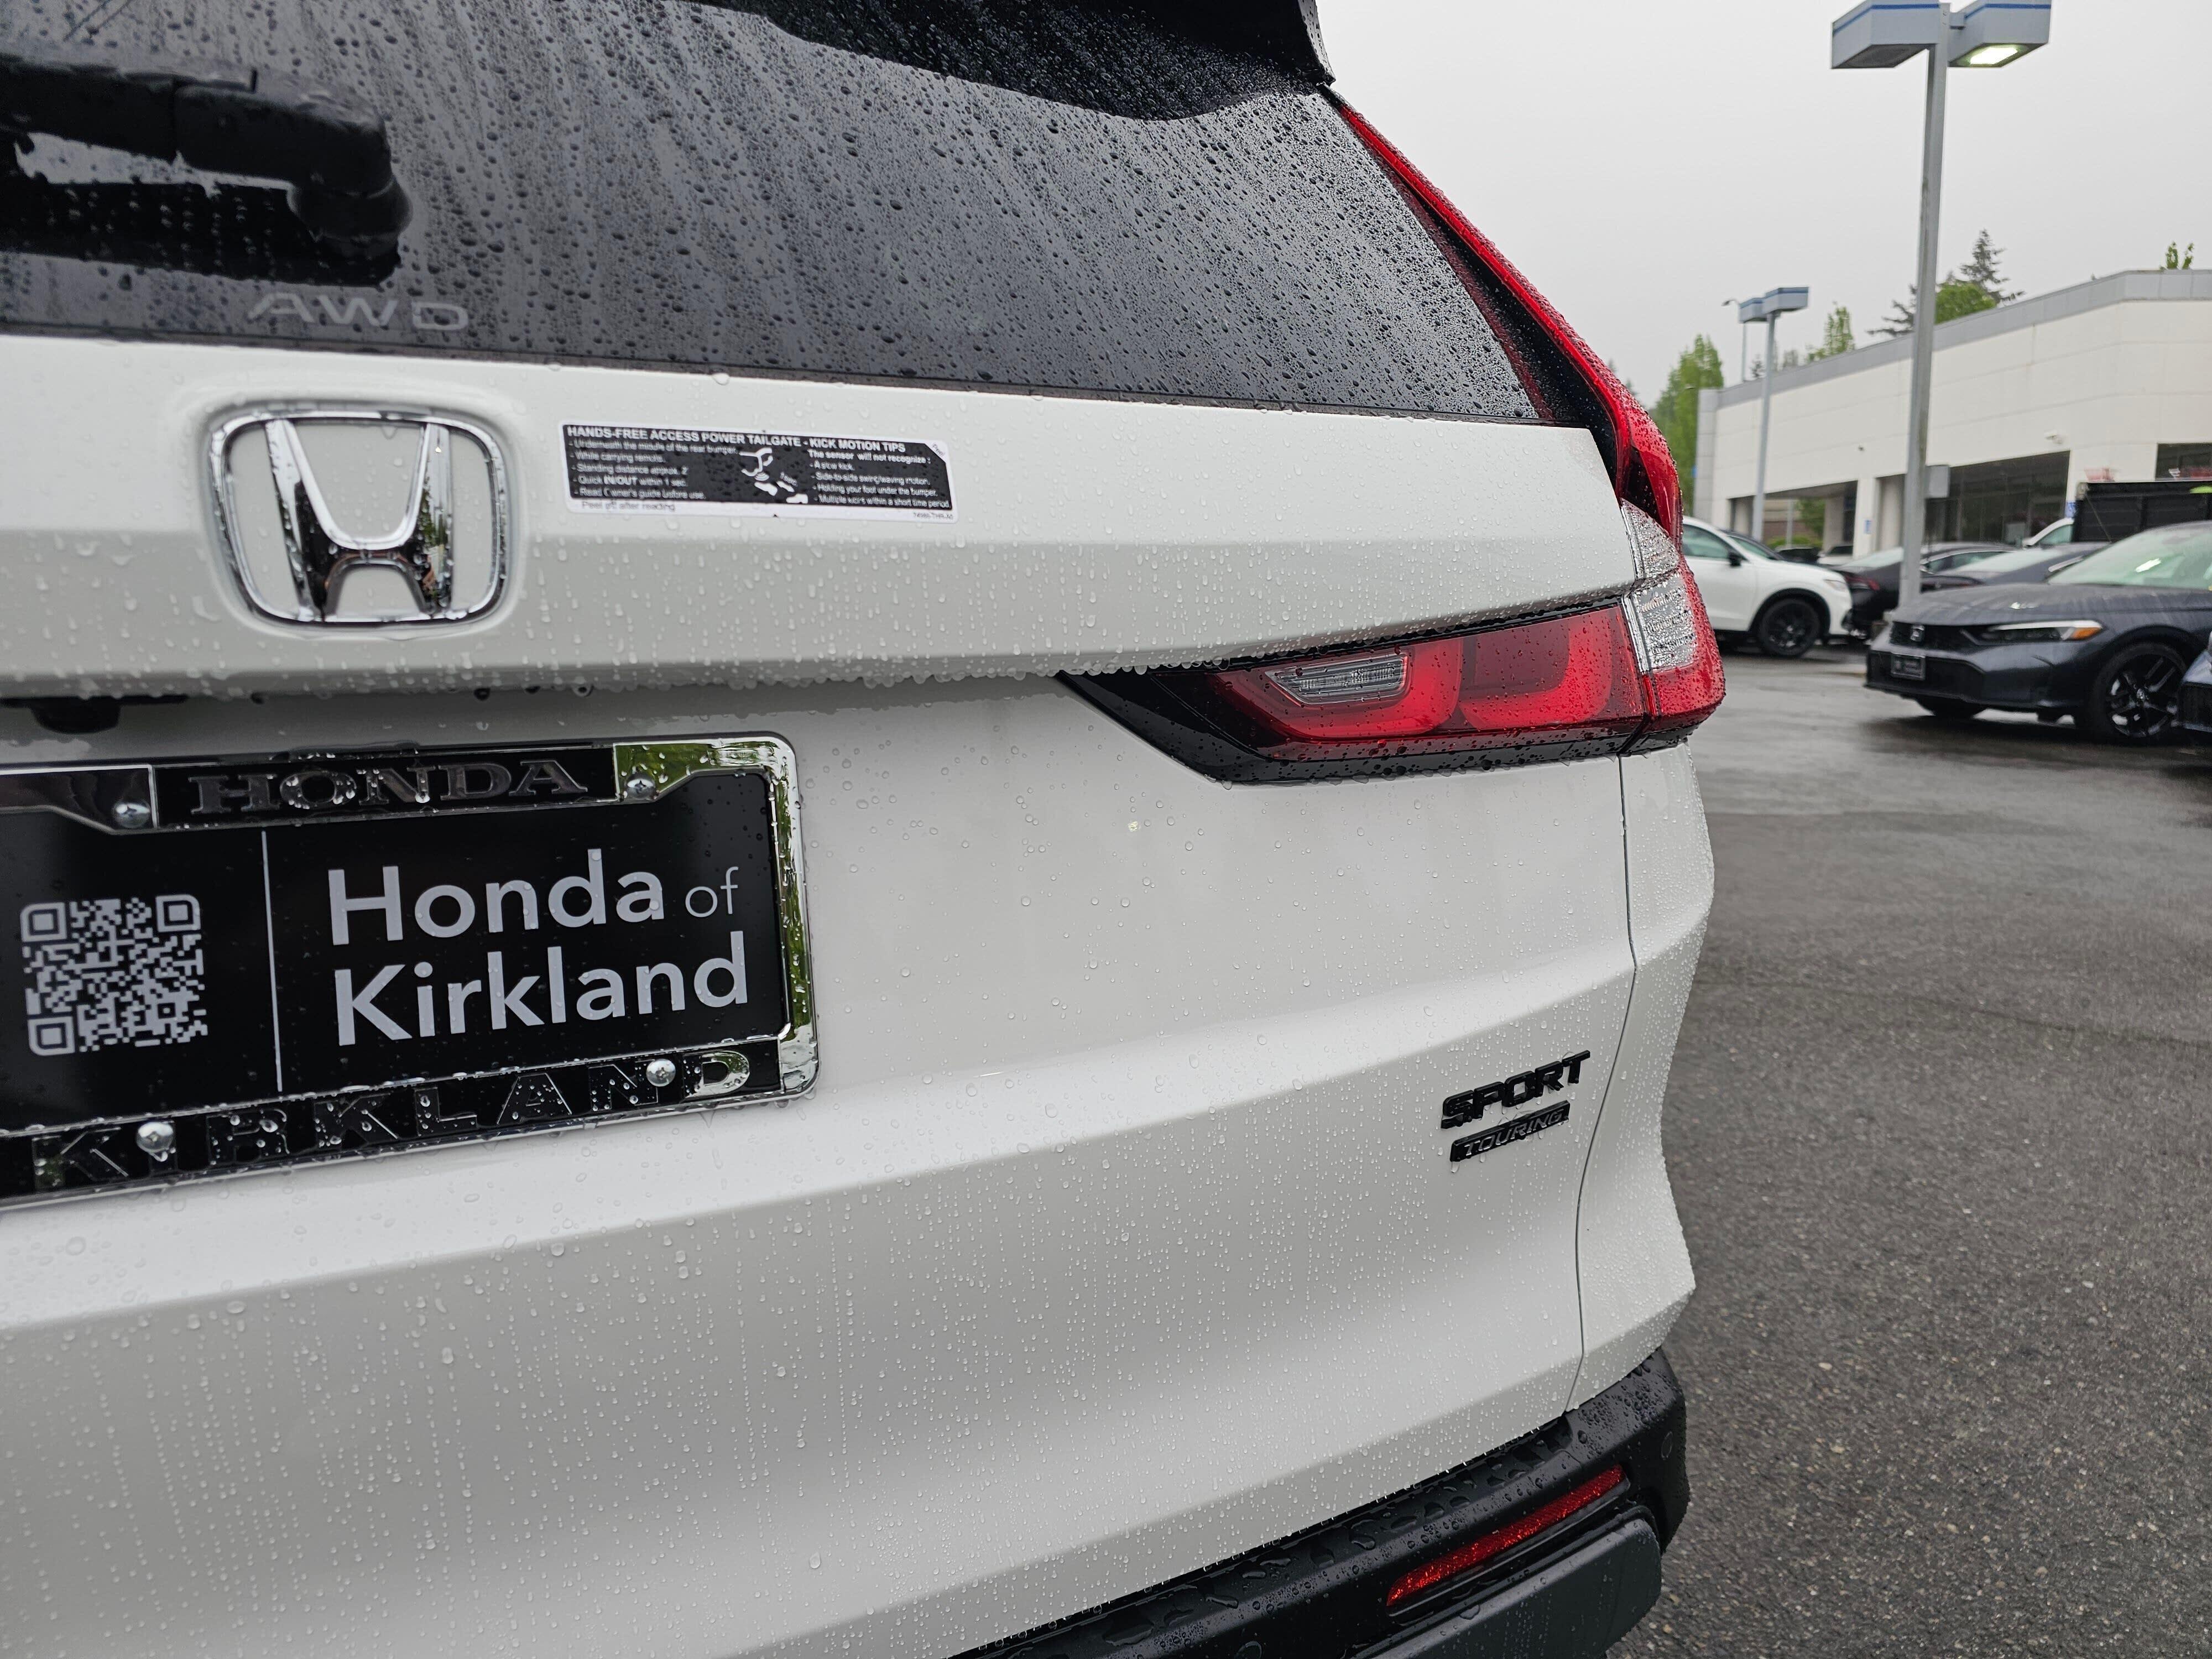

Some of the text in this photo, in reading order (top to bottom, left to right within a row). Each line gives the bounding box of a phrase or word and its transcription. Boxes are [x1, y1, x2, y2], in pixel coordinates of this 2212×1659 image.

[247, 292, 469, 331] AWD
[567, 426, 648, 440] HANDS-FREE
[650, 429, 700, 442] ACCESS
[701, 432, 745, 444] POWER
[747, 434, 801, 447] TAILGATE
[809, 437, 837, 449] KICK
[838, 439, 880, 451] MOTION
[881, 442, 906, 452] TIPS
[623, 440, 637, 450] the
[665, 442, 674, 451] of
[675, 443, 688, 452] the
[575, 450, 599, 460] While
[601, 452, 634, 463] carrying
[807, 448, 825, 458] The
[825, 451, 854, 460] sensor
[857, 452, 872, 461] will
[887, 455, 926, 465] recognize
[577, 462, 614, 474] Standing
[614, 463, 649, 474] distance
[814, 460, 821, 469] A
[578, 474, 603, 484] Quick
[603, 474, 638, 485] IN/OUT
[638, 476, 663, 486] within
[580, 486, 603, 497] Read
[638, 488, 661, 499] guide
[662, 489, 688, 499] before
[817, 482, 845, 494] Holding
[846, 486, 862, 495] your
[862, 484, 877, 494] foot
[877, 486, 897, 495] under
[898, 487, 910, 495] the
[582, 501, 603, 509] Peel
[619, 501, 640, 509] after
[818, 493, 847, 504] Multiple
[847, 496, 865, 504] kicks
[866, 496, 887, 505] within
[894, 497, 912, 507] short
[912, 498, 927, 507] time
[188, 759, 588, 815] HONDA
[328, 848, 739, 946] Honda of
[333, 930, 749, 1047] Kirkland
[1441, 1050, 1590, 1129] SPORT
[1464, 1108, 1565, 1157] TOURING
